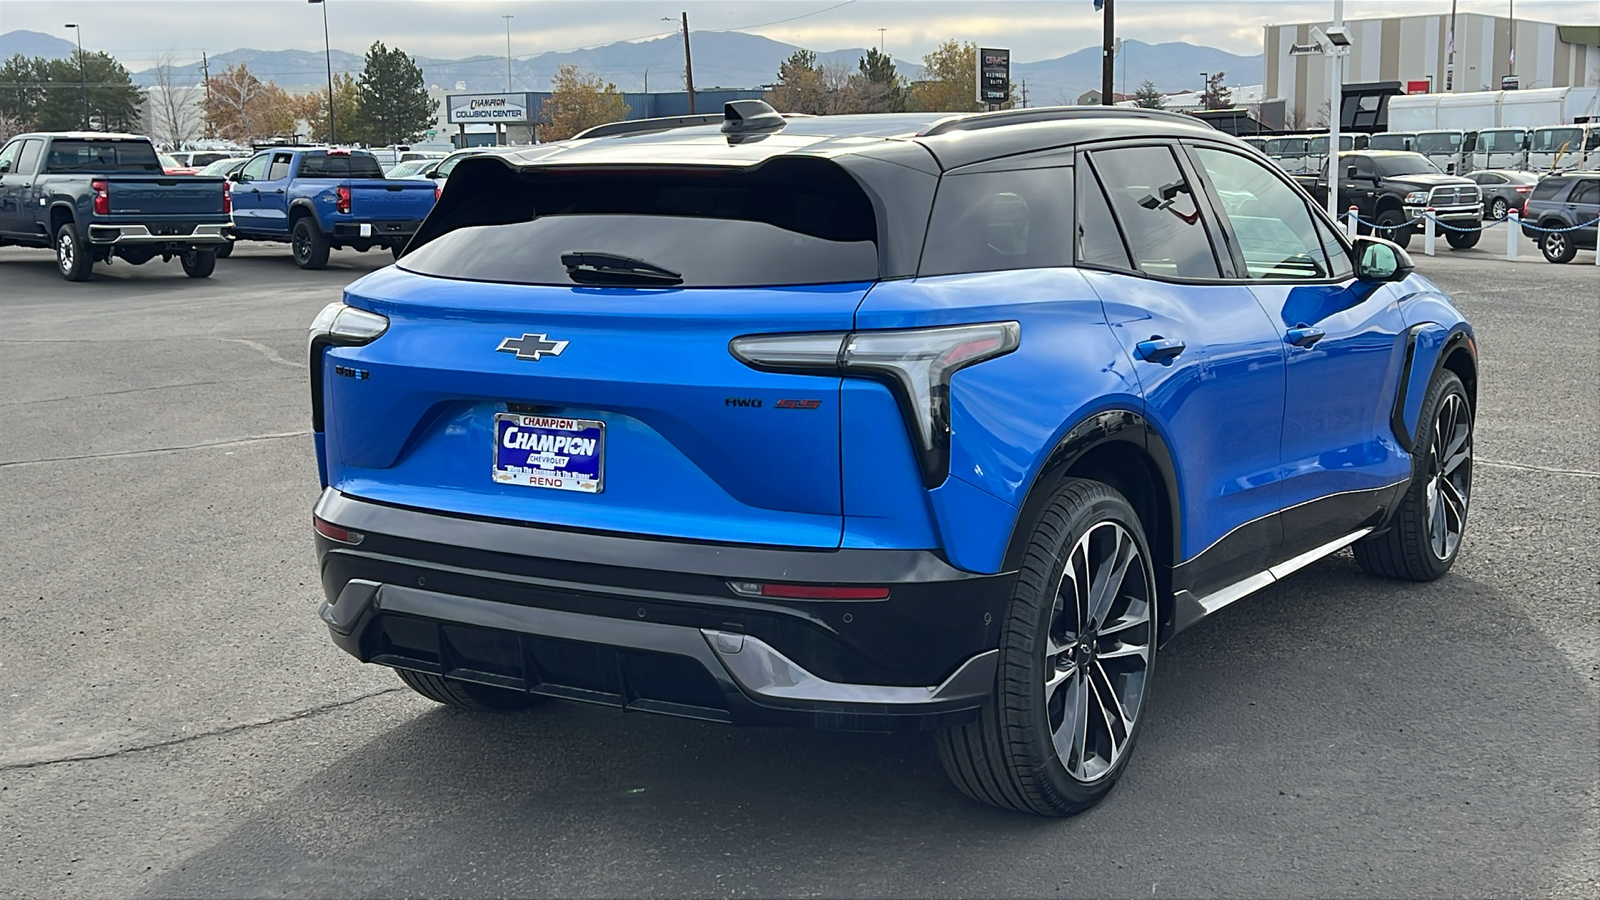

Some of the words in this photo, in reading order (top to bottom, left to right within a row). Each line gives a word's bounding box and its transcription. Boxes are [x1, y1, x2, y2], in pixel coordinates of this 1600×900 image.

[986, 56, 1007, 64] GMC
[470, 98, 505, 109] CHAMPION
[456, 110, 491, 118] COLLISION
[492, 109, 522, 117] CENTER
[725, 398, 762, 408] AWD
[773, 399, 822, 409] SS
[523, 417, 573, 429] CHAMPION
[503, 427, 596, 456] CHAMPION
[530, 455, 566, 465] CHEVROLET
[530, 476, 562, 487] RENO
